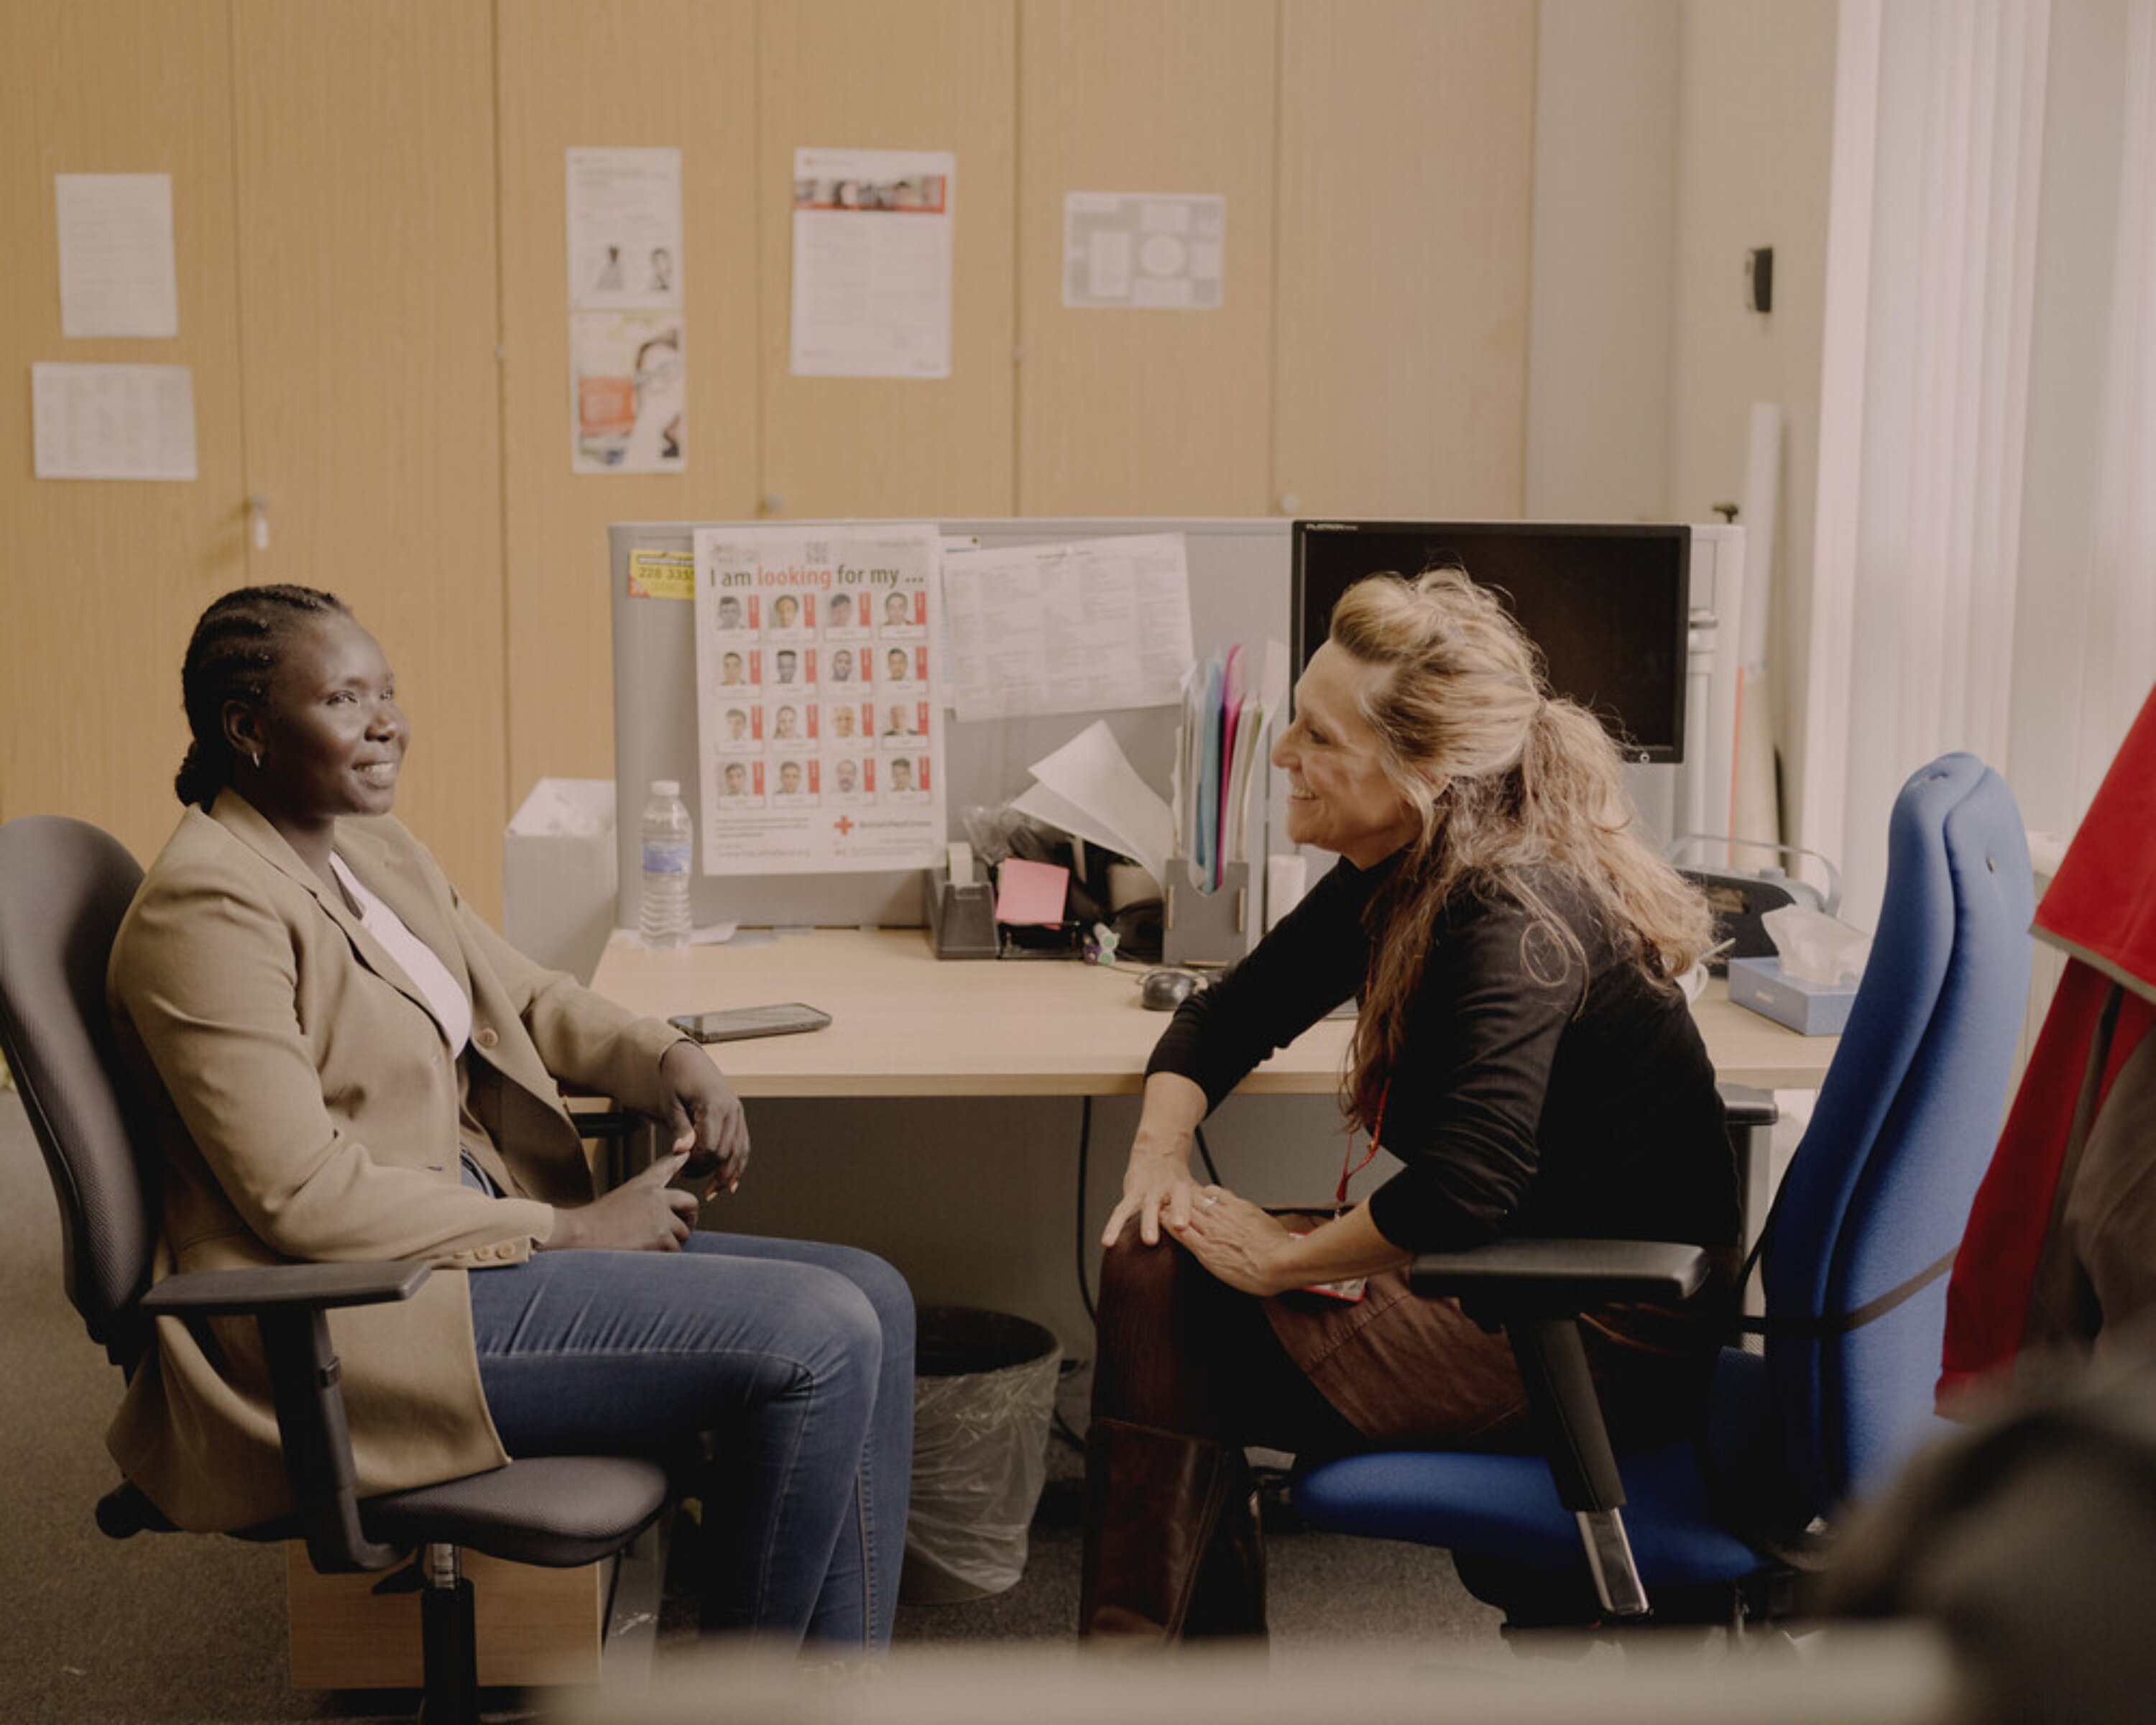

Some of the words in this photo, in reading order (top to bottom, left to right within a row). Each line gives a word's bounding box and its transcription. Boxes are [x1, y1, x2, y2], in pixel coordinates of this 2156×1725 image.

[711, 568, 716, 586] I
[722, 571, 752, 586] am
[758, 566, 831, 590] looking
[837, 564, 865, 585] for
[870, 568, 900, 588] my
